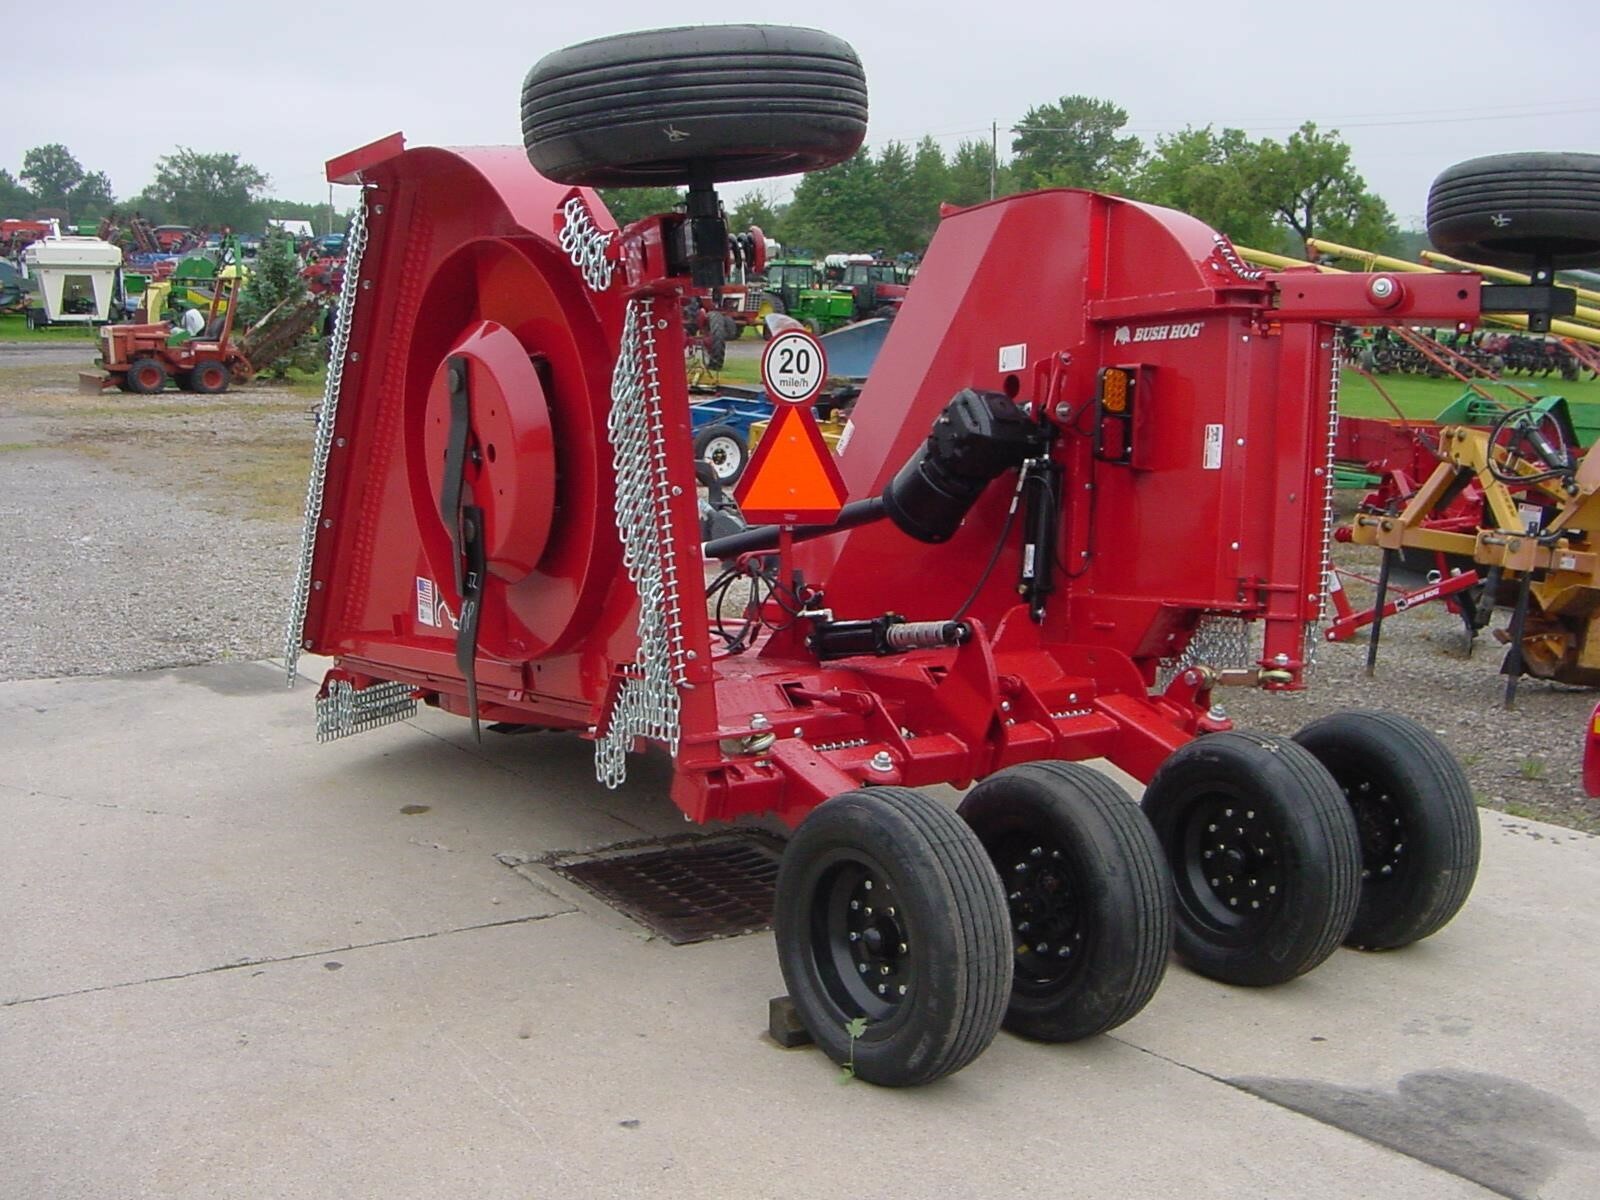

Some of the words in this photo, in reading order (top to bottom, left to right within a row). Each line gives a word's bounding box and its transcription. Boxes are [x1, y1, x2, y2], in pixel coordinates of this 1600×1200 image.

[1132, 325, 1169, 342] BUSH
[1169, 322, 1201, 339] HOG
[779, 348, 810, 375] 20
[779, 377, 809, 388] mile/h
